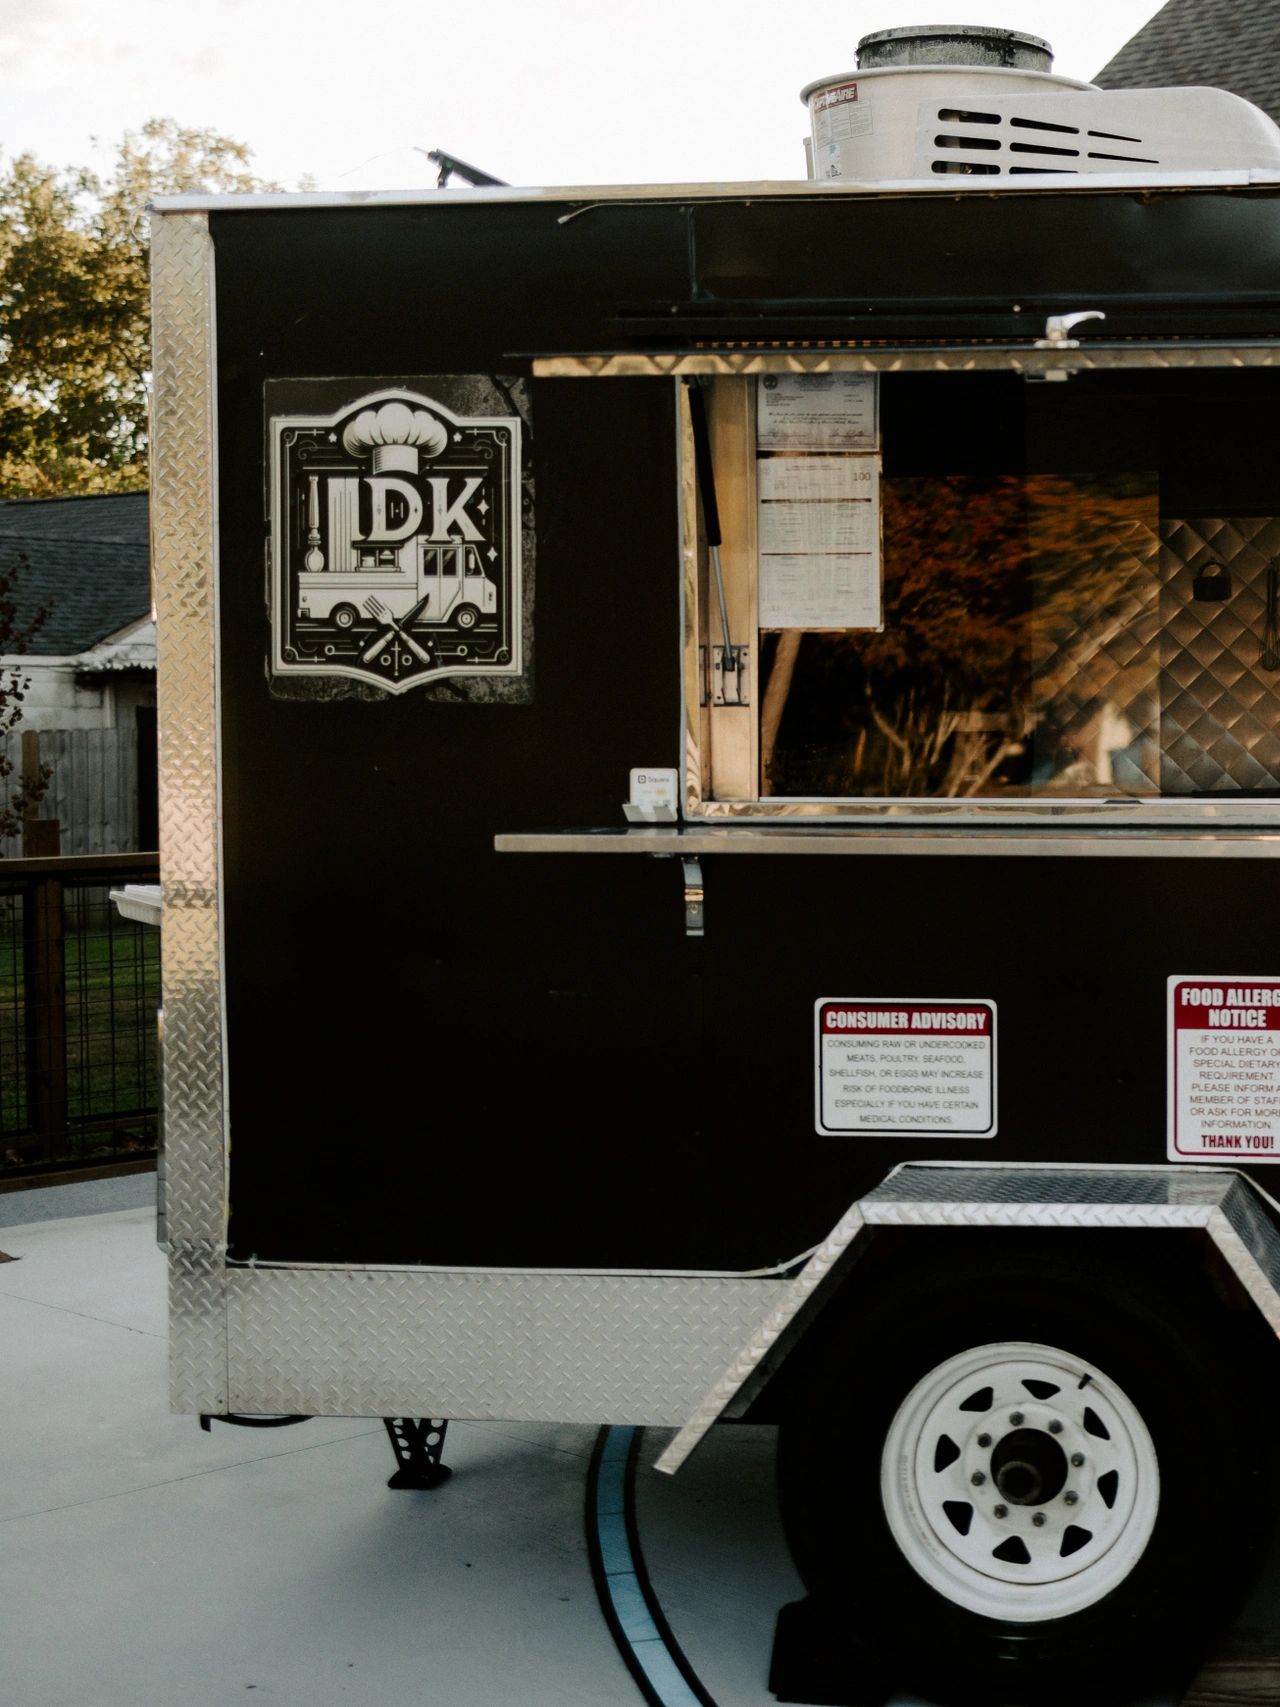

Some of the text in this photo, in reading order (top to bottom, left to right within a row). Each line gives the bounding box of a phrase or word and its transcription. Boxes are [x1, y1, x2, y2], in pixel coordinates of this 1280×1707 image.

[853, 472, 871, 481] 100
[1181, 988, 1224, 1006] FOOD
[826, 1011, 986, 1029] CONSUMER ADVISORY
[1208, 1009, 1267, 1027] NOTICE
[1201, 1035, 1274, 1044] IF YOU HAVE A
[827, 1040, 986, 1049] CONSUMING RAW OR UNDERCOOKED
[1189, 1047, 1218, 1055] FOOD
[1220, 1047, 1267, 1056] ALLERGY
[1193, 1059, 1280, 1068] SPECIAL DIETARY
[879, 1069, 892, 1077] OR
[895, 1069, 919, 1078] EGGS
[921, 1070, 938, 1078] MAY
[941, 1070, 985, 1079] INCREASE
[843, 1084, 970, 1094] RISK OF FOODBORNE ILLNESS
[1191, 1083, 1230, 1092] PLEASE
[1234, 1084, 1274, 1092] INFORM
[1190, 1095, 1234, 1104] MEMBER
[1237, 1096, 1249, 1104] OF
[834, 1100, 885, 1108] ESPECIALLY
[898, 1100, 915, 1108] YOU
[918, 1101, 940, 1109] HAVE
[942, 1101, 979, 1109] CERTAIN
[1190, 1107, 1205, 1116] OR
[1207, 1108, 1227, 1116] ASK
[1231, 1108, 1252, 1116] FOR
[860, 1115, 897, 1123] MEDICAL
[1201, 1135, 1275, 1149] THANK YOU!
